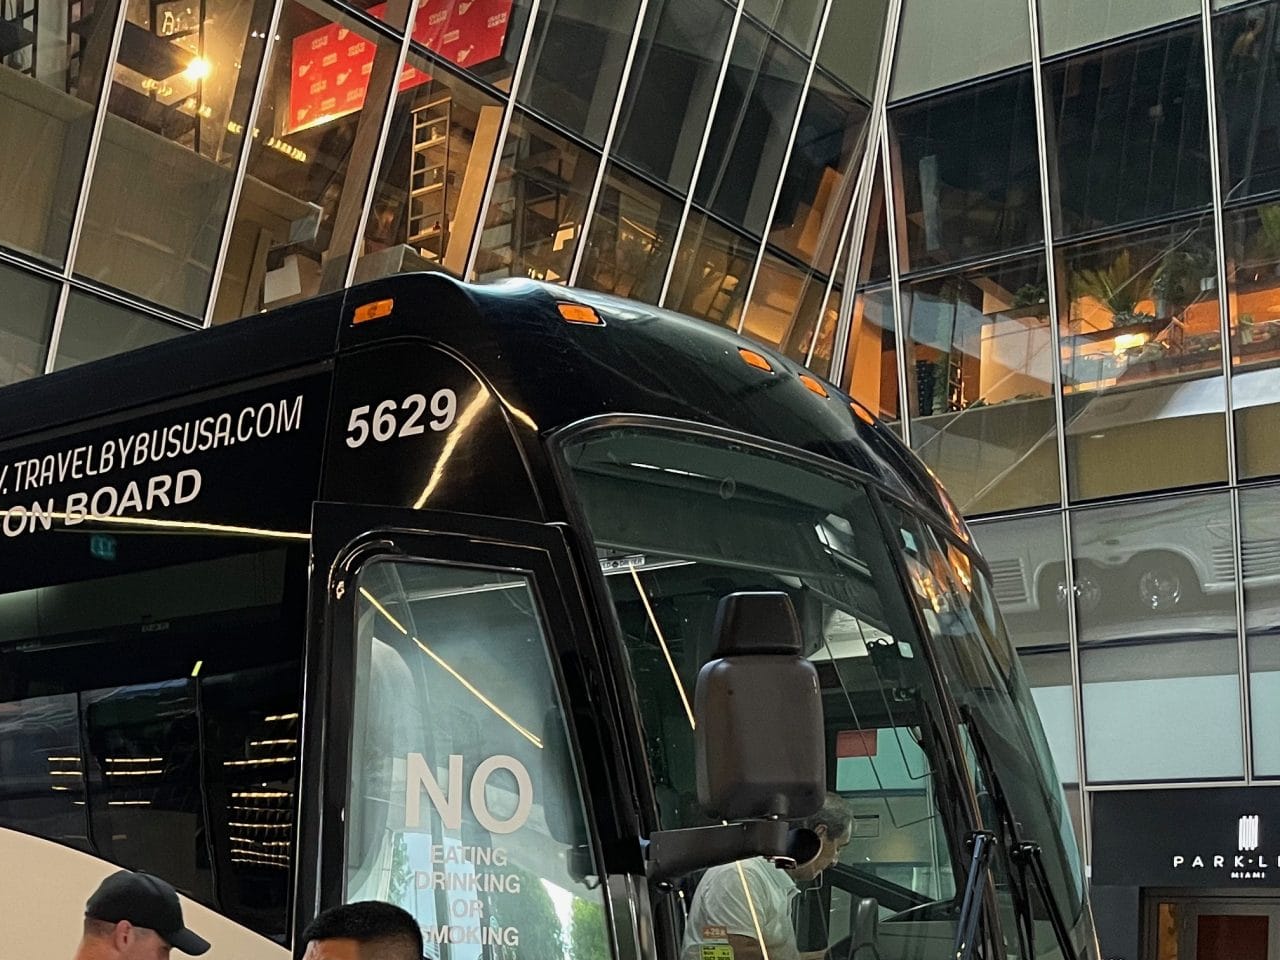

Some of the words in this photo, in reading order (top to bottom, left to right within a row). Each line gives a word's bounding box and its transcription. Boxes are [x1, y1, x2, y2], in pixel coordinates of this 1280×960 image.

[345, 388, 457, 448] 5629
[3, 499, 54, 537] ON
[64, 469, 202, 526] BOARD
[405, 752, 533, 834] NO
[430, 844, 508, 867] EATING
[415, 870, 520, 893] DRINKING
[1231, 871, 1265, 879] MIAMI
[452, 899, 484, 919] OR
[421, 926, 519, 947] SMOKING
